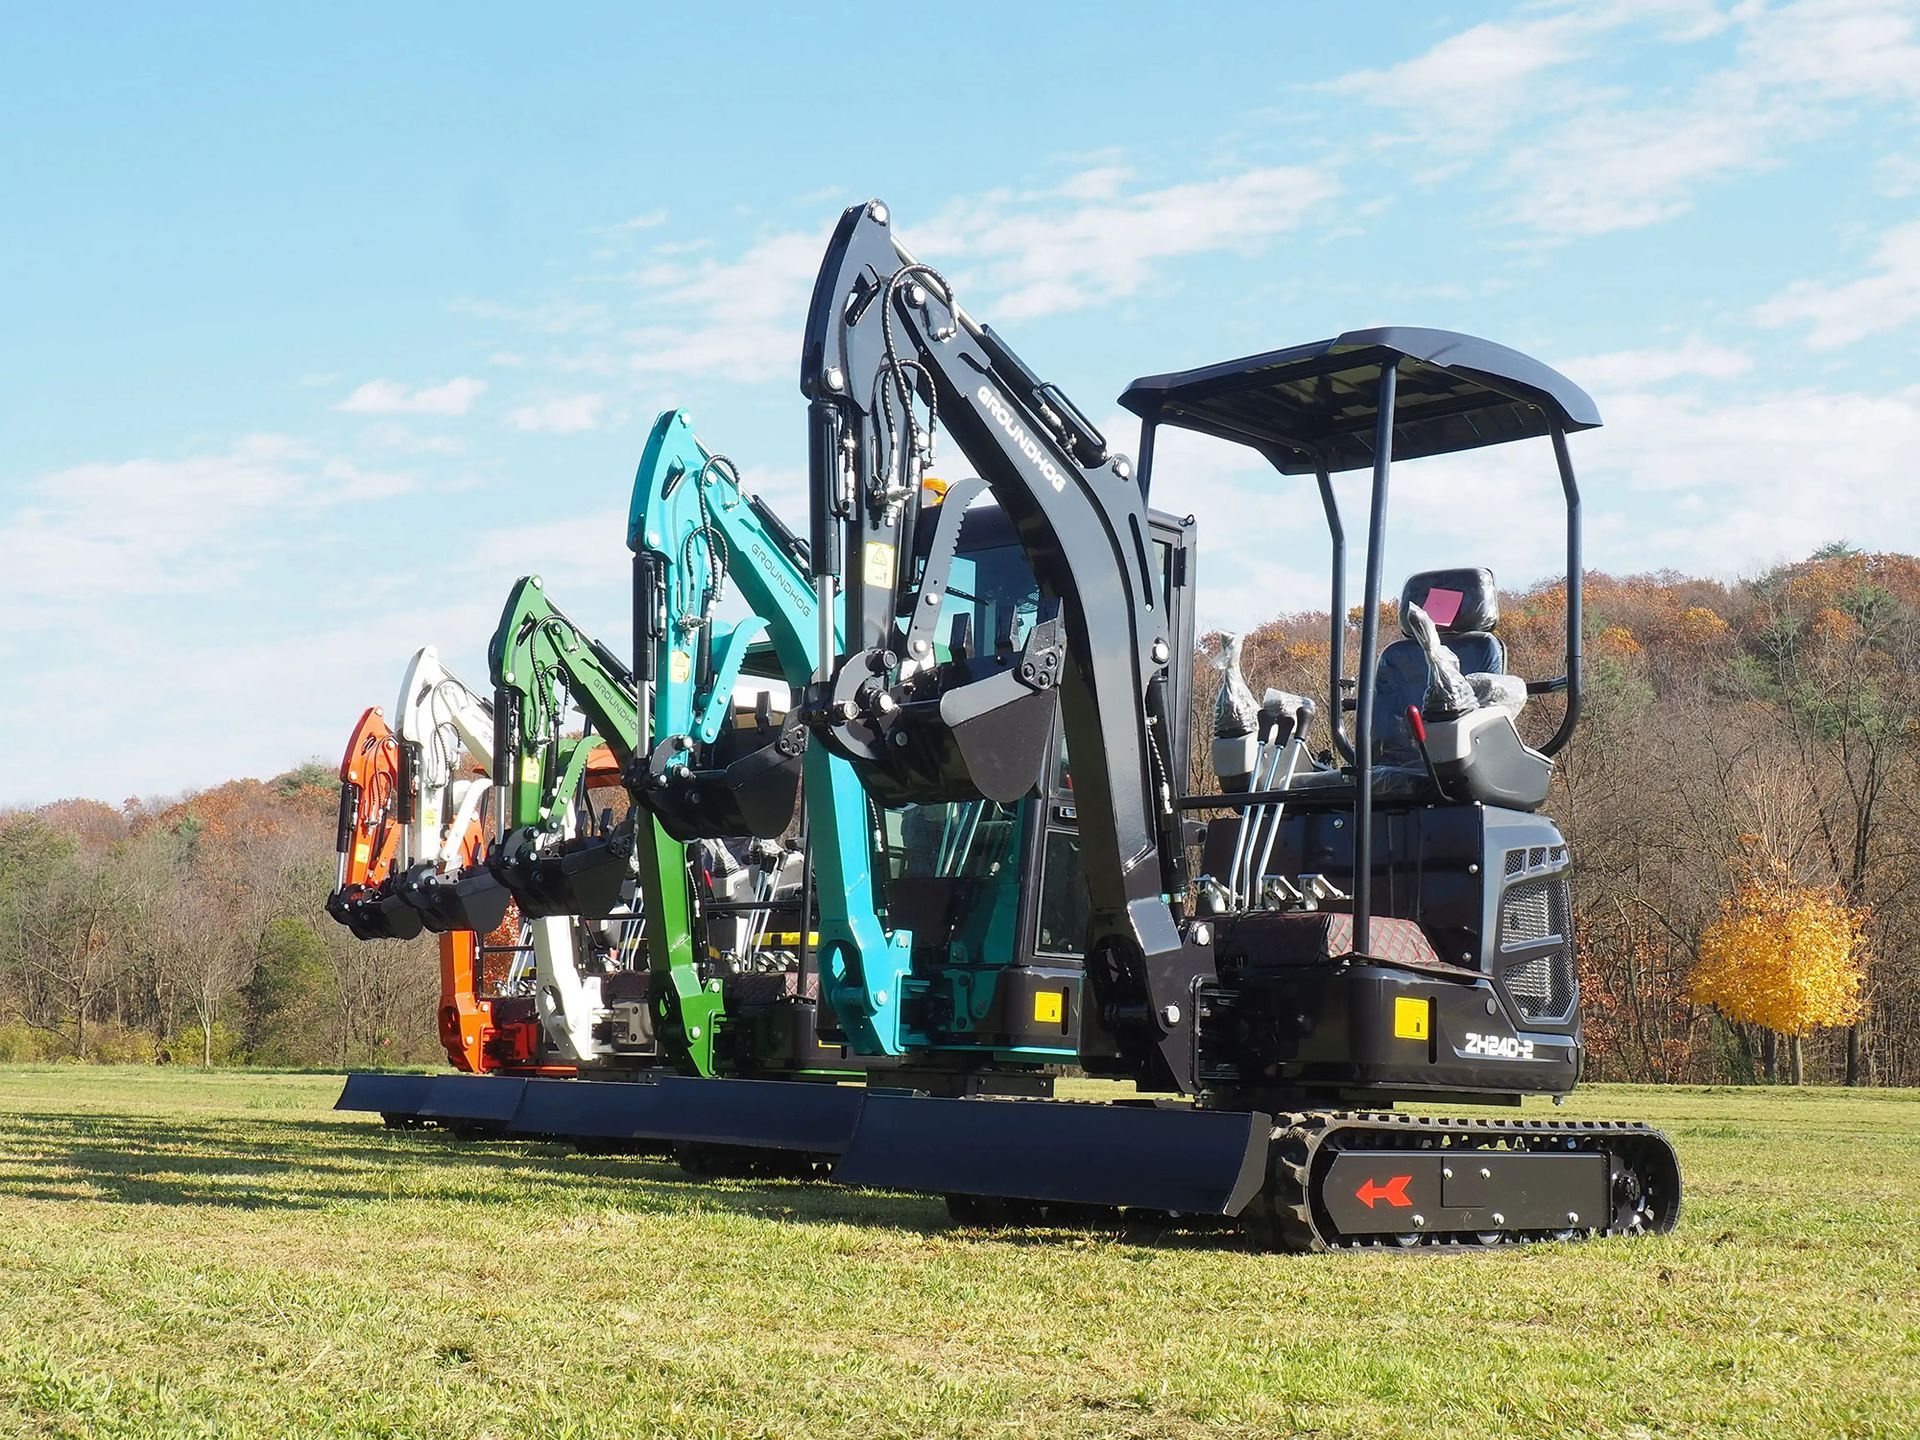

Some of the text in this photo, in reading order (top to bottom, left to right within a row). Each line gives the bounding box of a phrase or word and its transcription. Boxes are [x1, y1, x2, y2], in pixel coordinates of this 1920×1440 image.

[977, 385, 1066, 493] GROUNDHOG
[751, 543, 811, 617] GROUNDHOG
[593, 679, 638, 734] GROUNDHO
